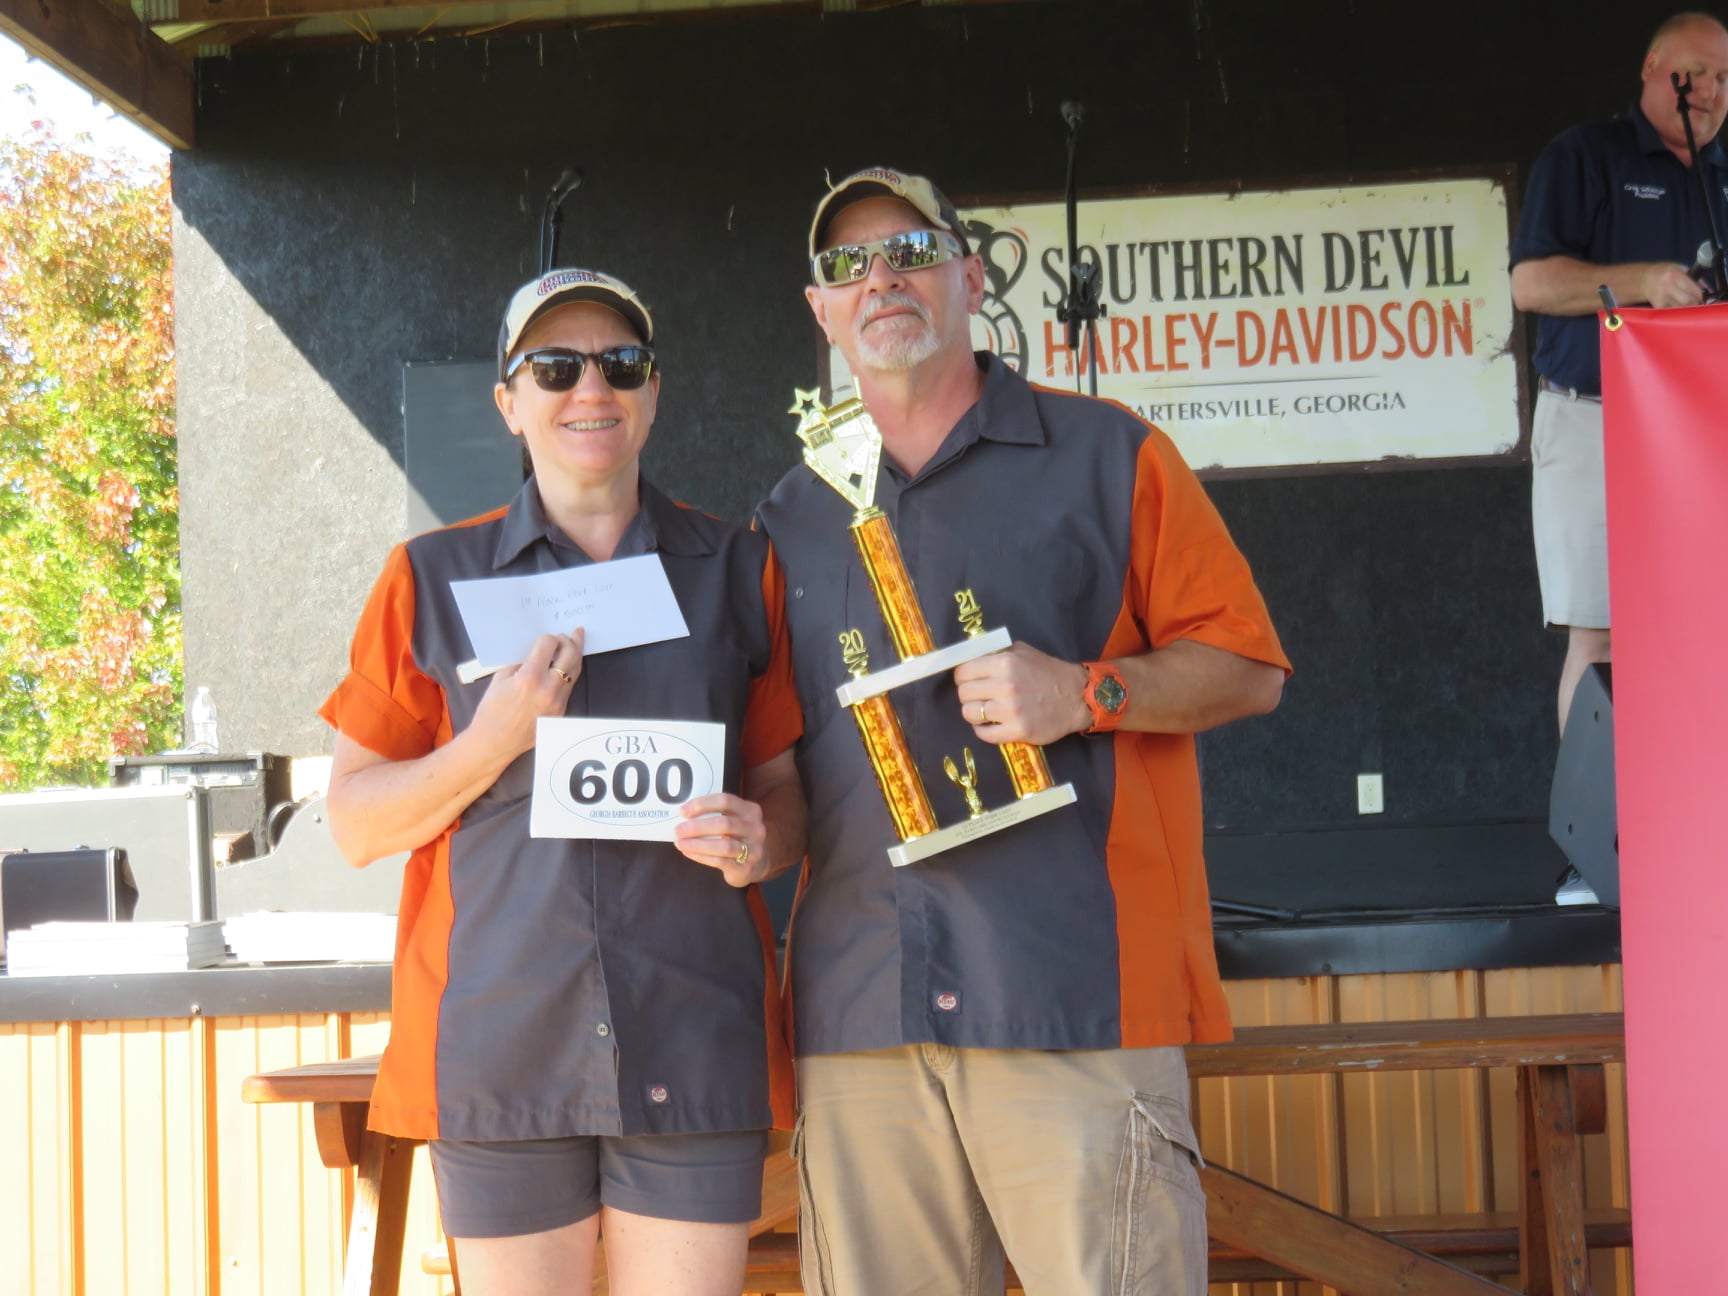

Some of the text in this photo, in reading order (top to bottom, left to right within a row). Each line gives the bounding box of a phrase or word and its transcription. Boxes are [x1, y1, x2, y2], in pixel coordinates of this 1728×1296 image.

[1041, 225, 1470, 309] SOUTHERN DEVIL
[1044, 299, 1473, 378] HARLEY-DAVIDSON
[1130, 393, 1406, 421] ARTERSVILLE, GEORGIA
[955, 588, 979, 612] 21
[839, 629, 865, 653] 20
[606, 736, 657, 754] GBA
[569, 758, 693, 805] 600
[590, 810, 611, 818] GEORGIA
[638, 810, 669, 818] ASSOCIATION
